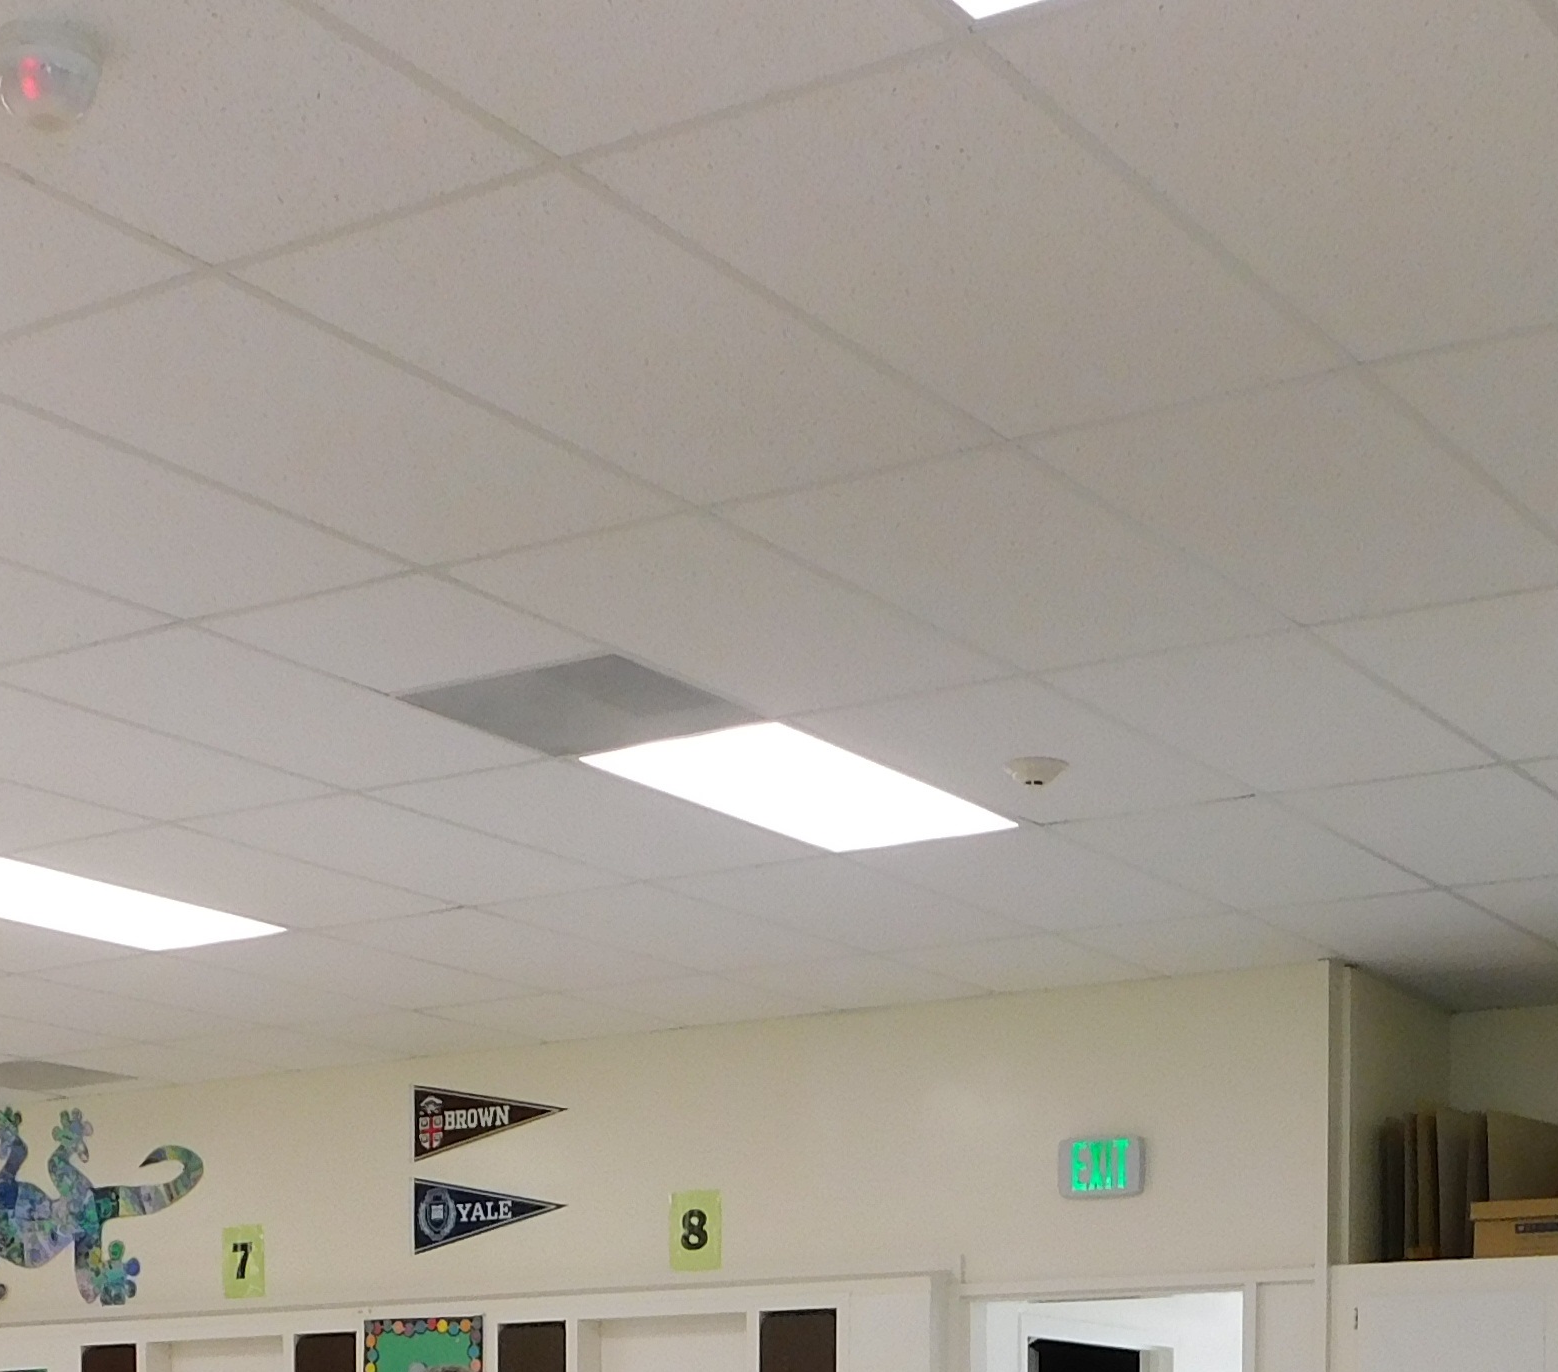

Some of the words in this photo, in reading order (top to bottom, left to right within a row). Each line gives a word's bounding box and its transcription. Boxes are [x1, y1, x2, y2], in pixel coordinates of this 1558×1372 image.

[443, 1105, 510, 1131] BROWN
[1071, 1138, 1129, 1191] EXIT
[456, 1200, 512, 1222] YALE
[680, 1209, 709, 1251] 8
[231, 1242, 253, 1279] 7
